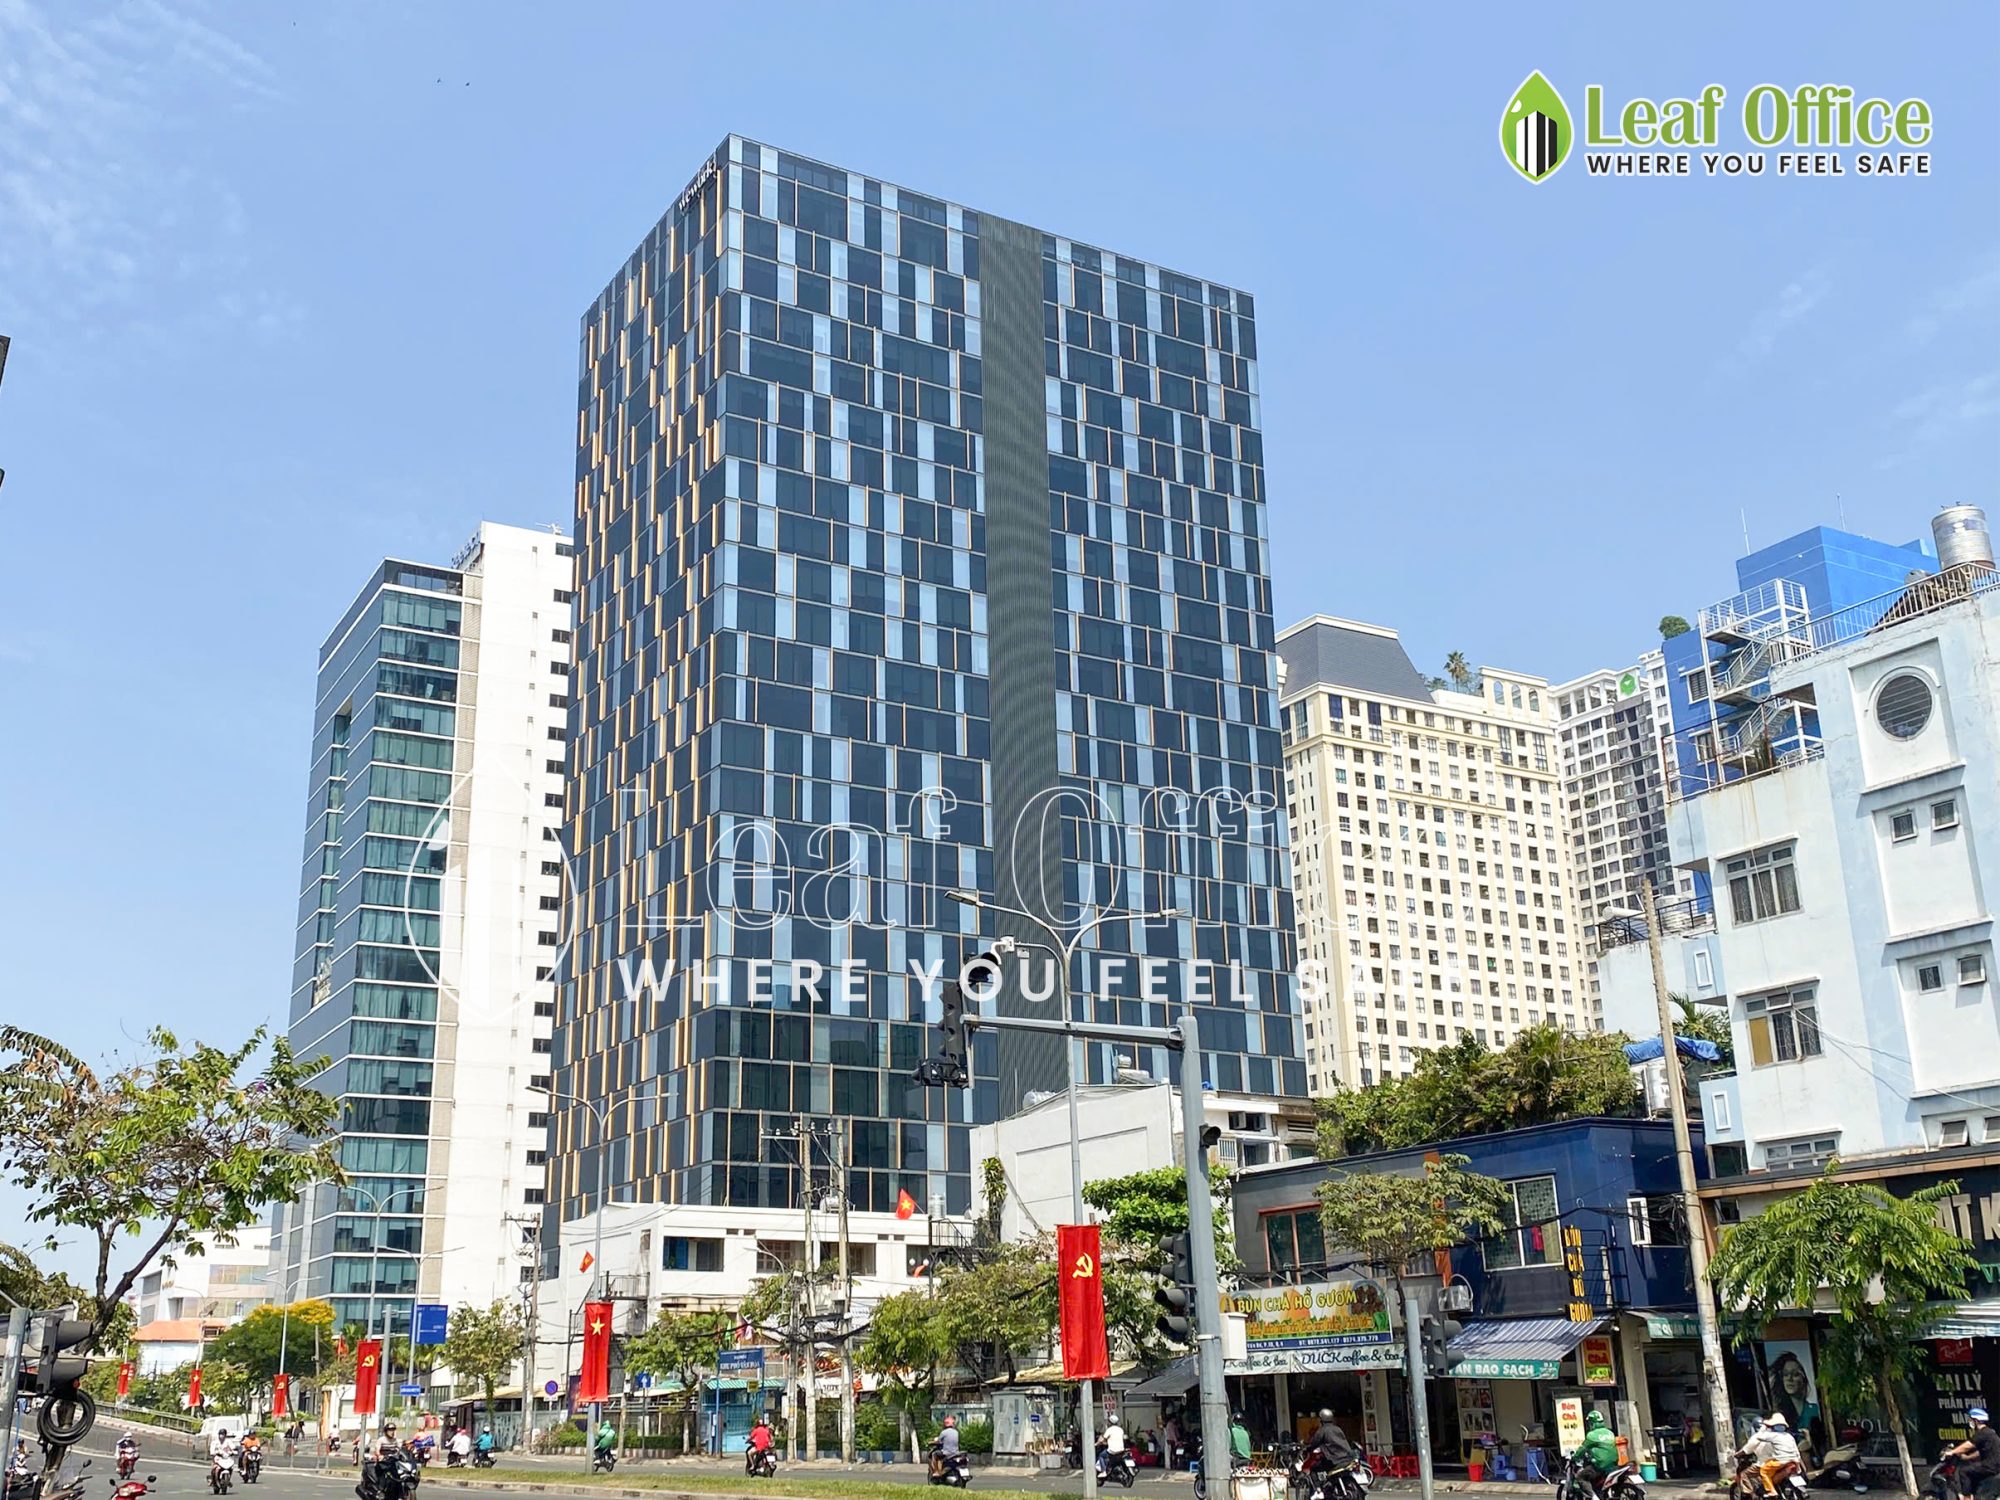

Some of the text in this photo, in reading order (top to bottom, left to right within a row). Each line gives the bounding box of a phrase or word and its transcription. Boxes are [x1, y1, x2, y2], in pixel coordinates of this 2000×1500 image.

[1264, 1291, 1289, 1310] CHẢ
[1294, 1286, 1313, 1309] HỒ
[1301, 1350, 1341, 1365] DUCK
[1475, 1364, 1499, 1375] BAO
